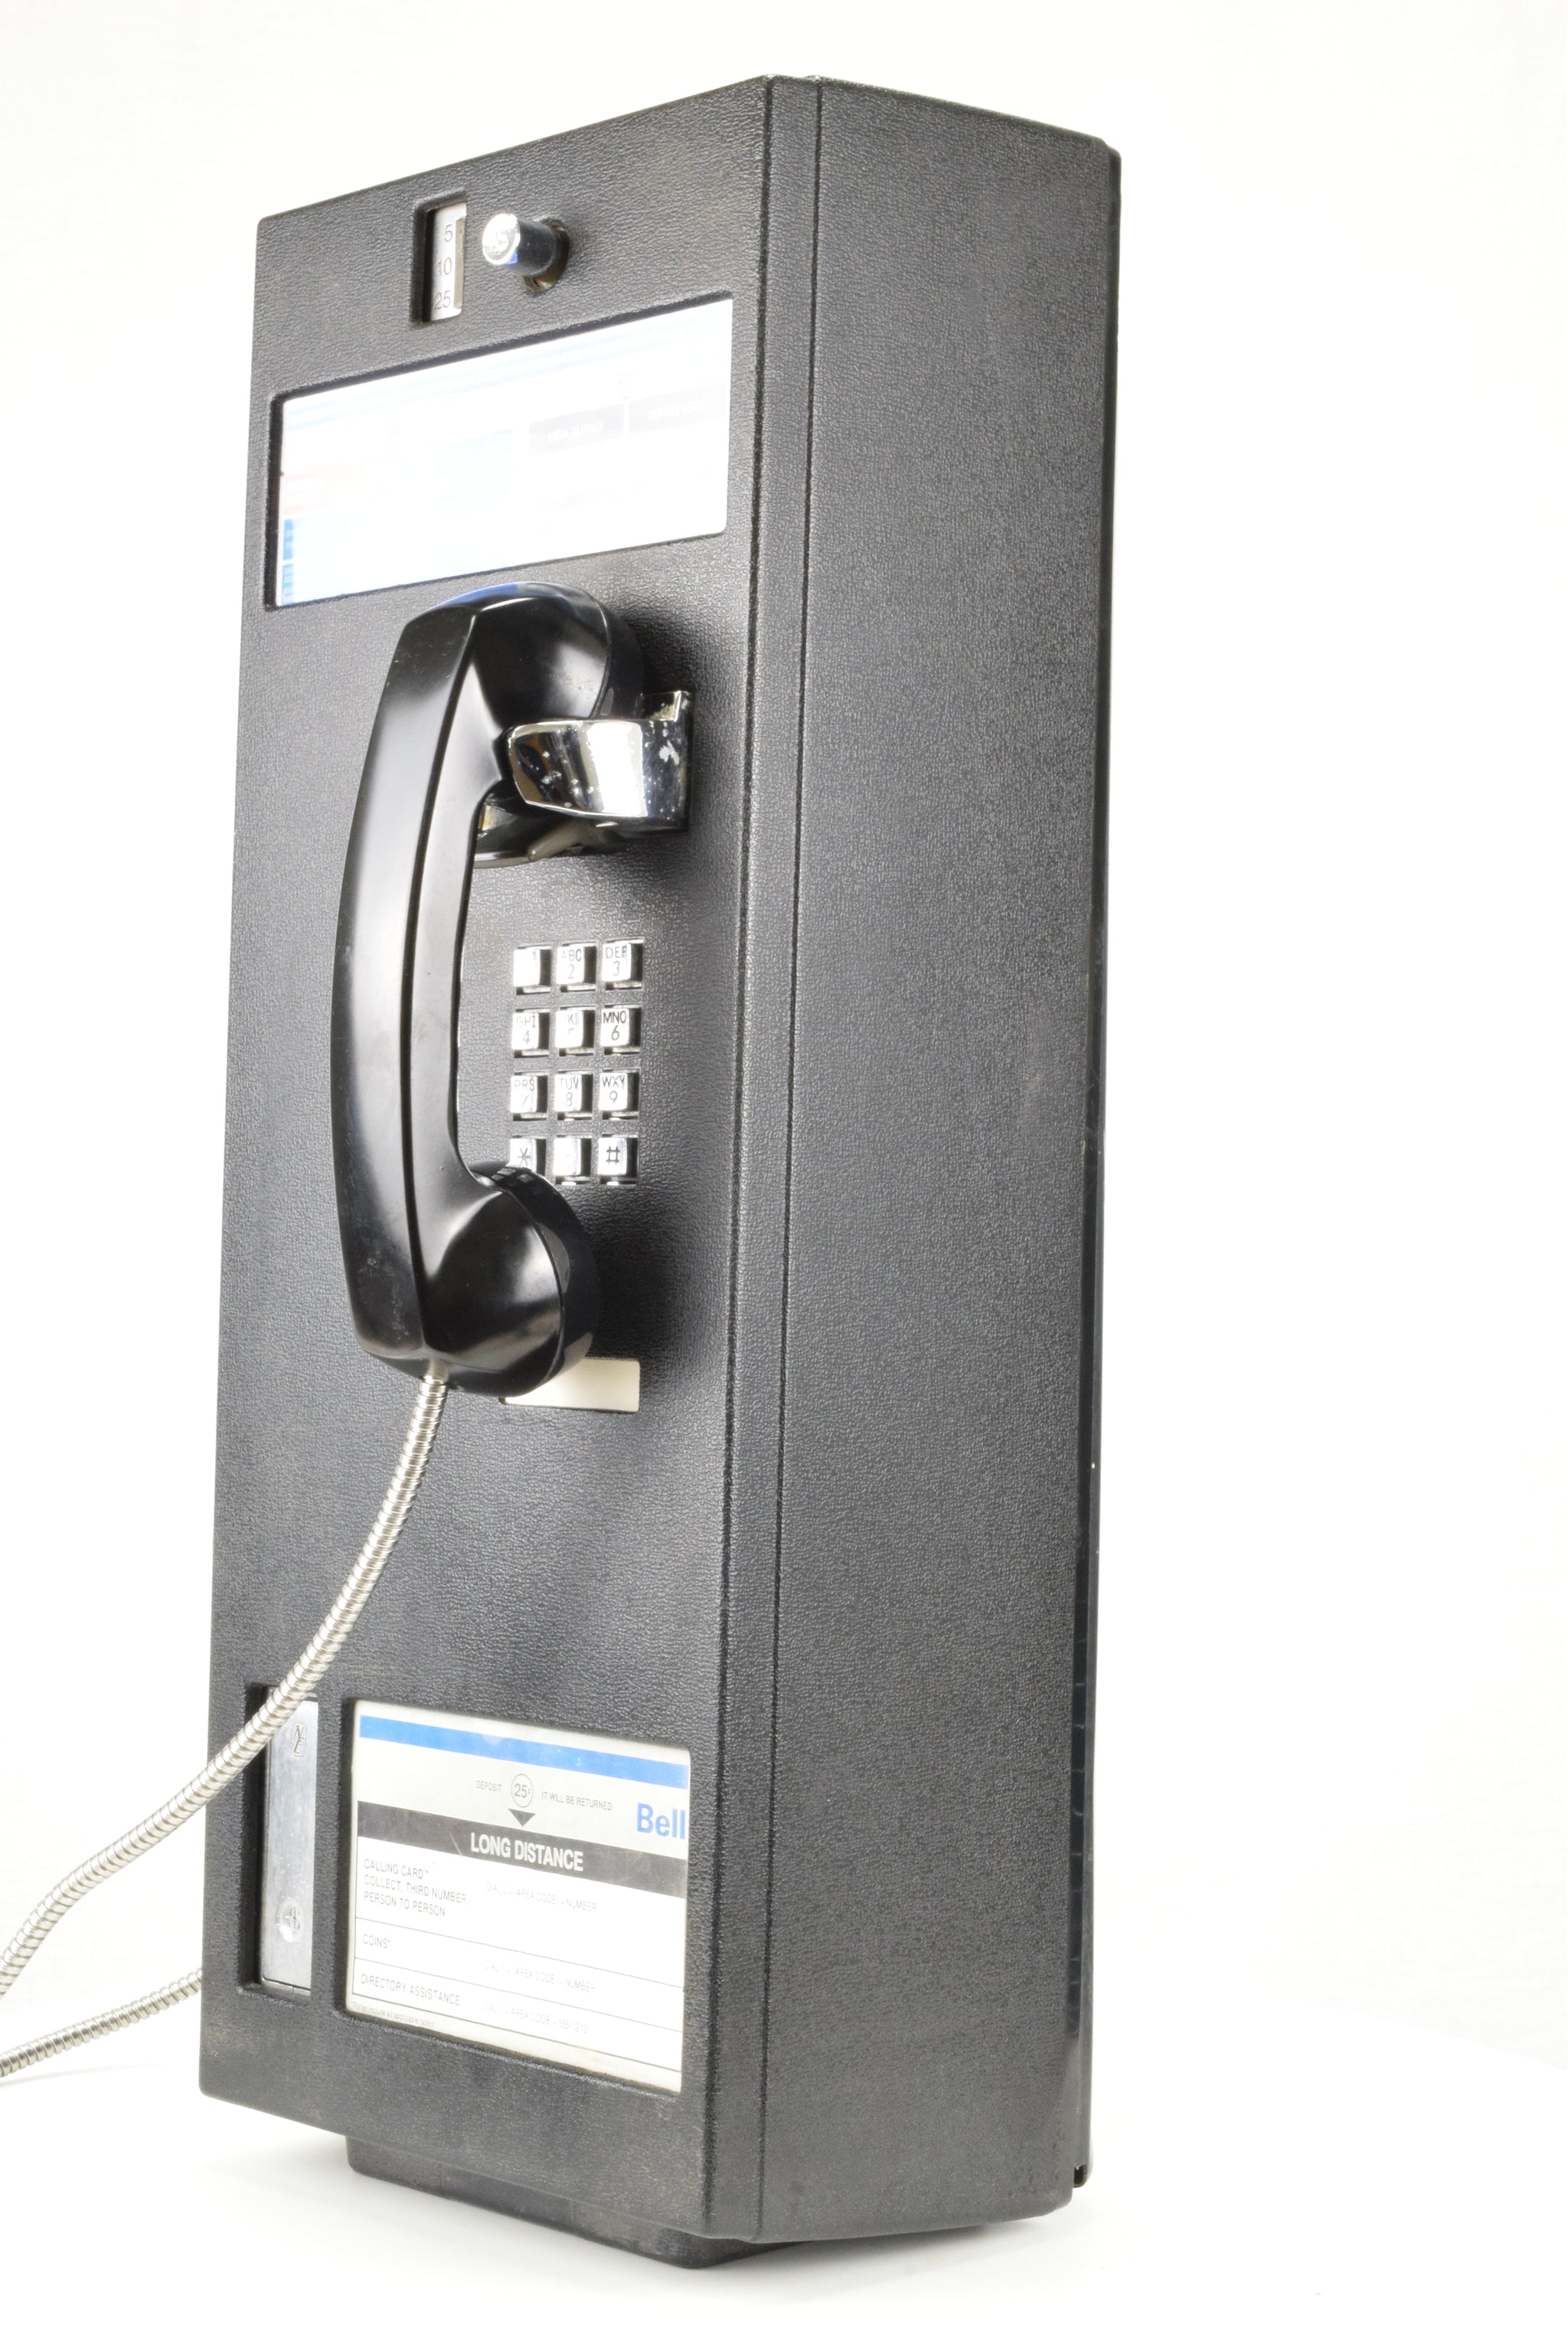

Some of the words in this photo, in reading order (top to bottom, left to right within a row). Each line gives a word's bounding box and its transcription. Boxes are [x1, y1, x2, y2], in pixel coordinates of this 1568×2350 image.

[444, 224, 452, 243] 5
[436, 257, 452, 276] 10
[433, 289, 452, 310] 25
[561, 948, 582, 963] ABC
[605, 946, 627, 959] DEF
[567, 963, 575, 980] 2
[612, 960, 621, 976] 3
[516, 1015, 536, 1029] GHI
[603, 1010, 627, 1025] MNO
[521, 1029, 531, 1045] 4
[611, 1025, 621, 1041] 6
[514, 1077, 535, 1092] PRS
[558, 1077, 579, 1090] TUV
[602, 1075, 626, 1089] WXY
[565, 1091, 573, 1107] 8
[609, 1090, 619, 1104] 9
[476, 1780, 502, 1793] DEPOSIT
[549, 1792, 564, 1804] WILL
[565, 1795, 574, 1806] BE
[576, 1796, 612, 1812] RETURNED
[636, 1802, 686, 1840] Bell
[471, 1832, 511, 1858] LONG
[514, 1840, 584, 1872] DISTANCE
[364, 1858, 399, 1875] CALLING
[364, 1874, 403, 1894] COLLECT,
[406, 1882, 430, 1897] THIRD
[364, 1890, 397, 1907] PERSON
[398, 1897, 410, 1910] TO
[412, 1901, 446, 1917] PERSON
[566, 1897, 598, 1913] NUMBER
[361, 1972, 407, 1994] DIRECTORY
[409, 1985, 461, 2007] ASSISTANCE
[565, 1977, 596, 1992] NUMBER
